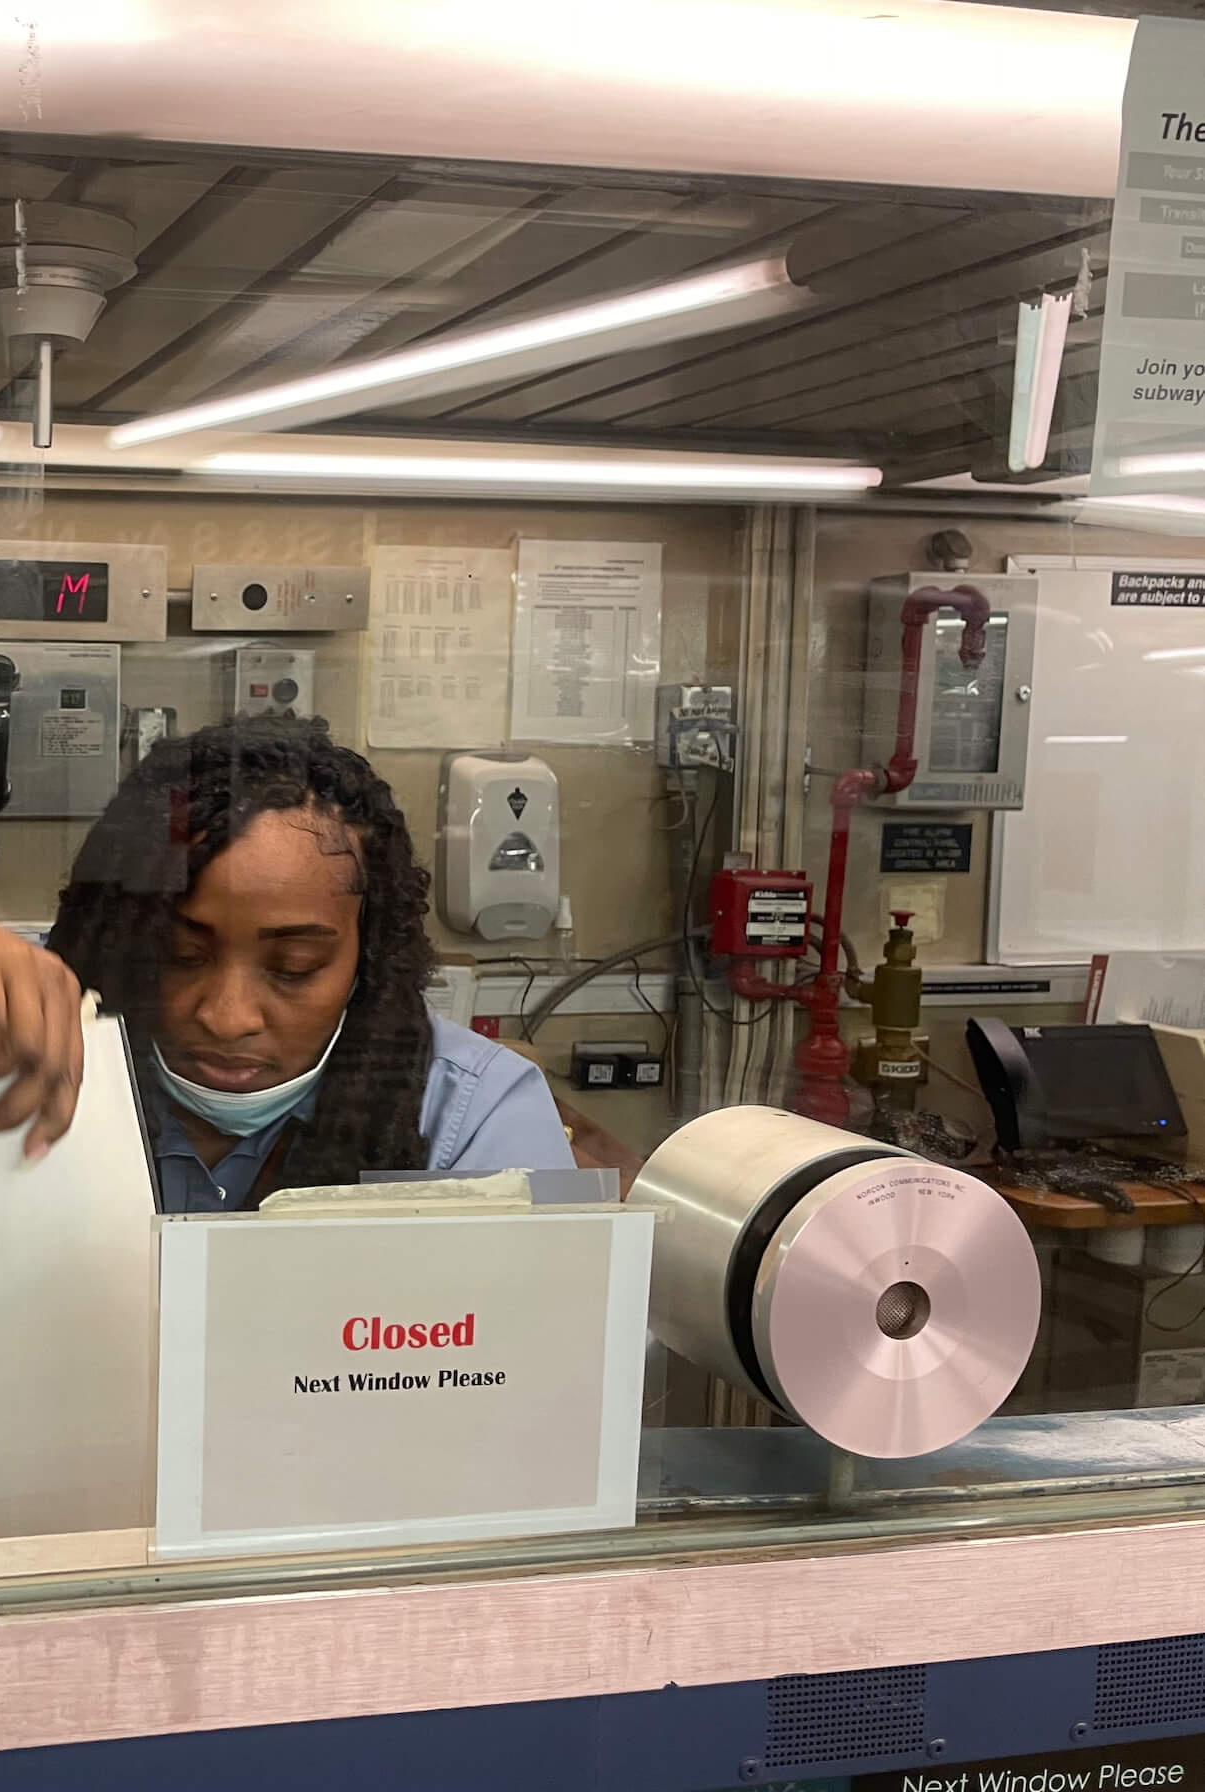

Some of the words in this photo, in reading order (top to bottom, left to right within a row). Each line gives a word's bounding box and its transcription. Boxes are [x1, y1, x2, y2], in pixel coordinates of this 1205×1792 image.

[1161, 112, 1205, 142] The
[1136, 358, 1177, 375] Join
[1133, 384, 1205, 406] subway
[56, 572, 91, 615] M
[1119, 575, 1185, 590] Backpacks
[1117, 592, 1137, 603] are
[1140, 590, 1185, 605] subject
[1187, 592, 1200, 604] to
[342, 1313, 475, 1351] Closed
[294, 1374, 340, 1394] Next
[348, 1372, 431, 1392] Window
[438, 1368, 506, 1388] Please
[902, 1772, 969, 1792] Next
[979, 1768, 1091, 1792] Window
[1098, 1763, 1185, 1789] Please
